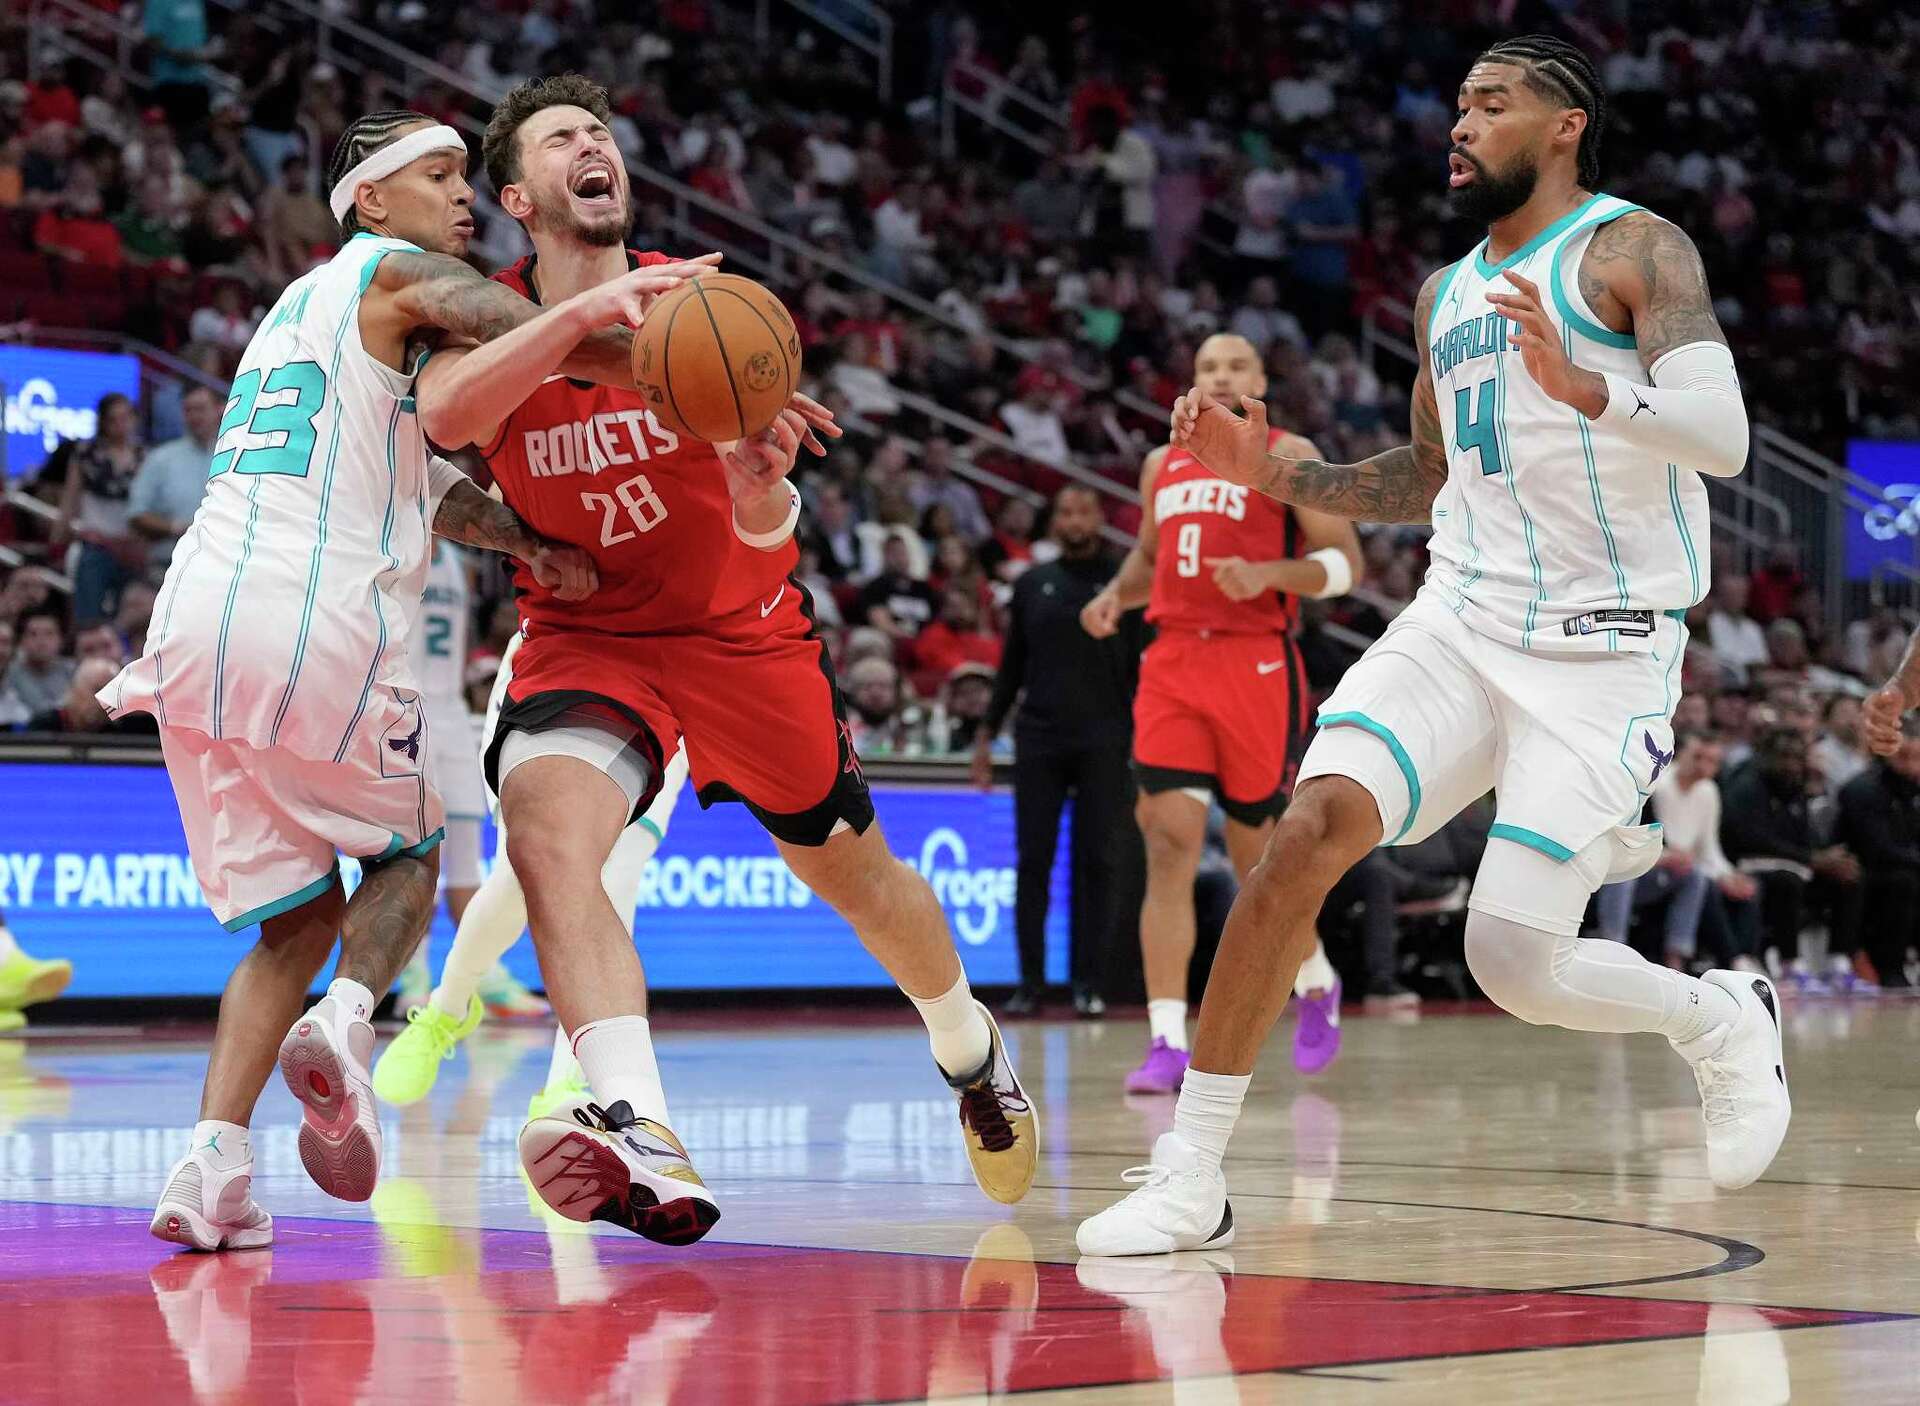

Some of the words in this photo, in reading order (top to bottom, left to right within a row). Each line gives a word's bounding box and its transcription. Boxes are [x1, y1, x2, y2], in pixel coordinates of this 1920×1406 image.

[1431, 311, 1522, 379] CHARLOT
[207, 360, 326, 480] 23
[524, 409, 679, 477] ROCKETS
[1455, 378, 1502, 476] 4
[580, 474, 668, 548] 28
[1177, 523, 1201, 578] 9
[425, 614, 451, 657] 2
[55, 853, 209, 908] PARTN
[637, 855, 812, 909] ROCKETS
[904, 827, 1017, 946] roge
